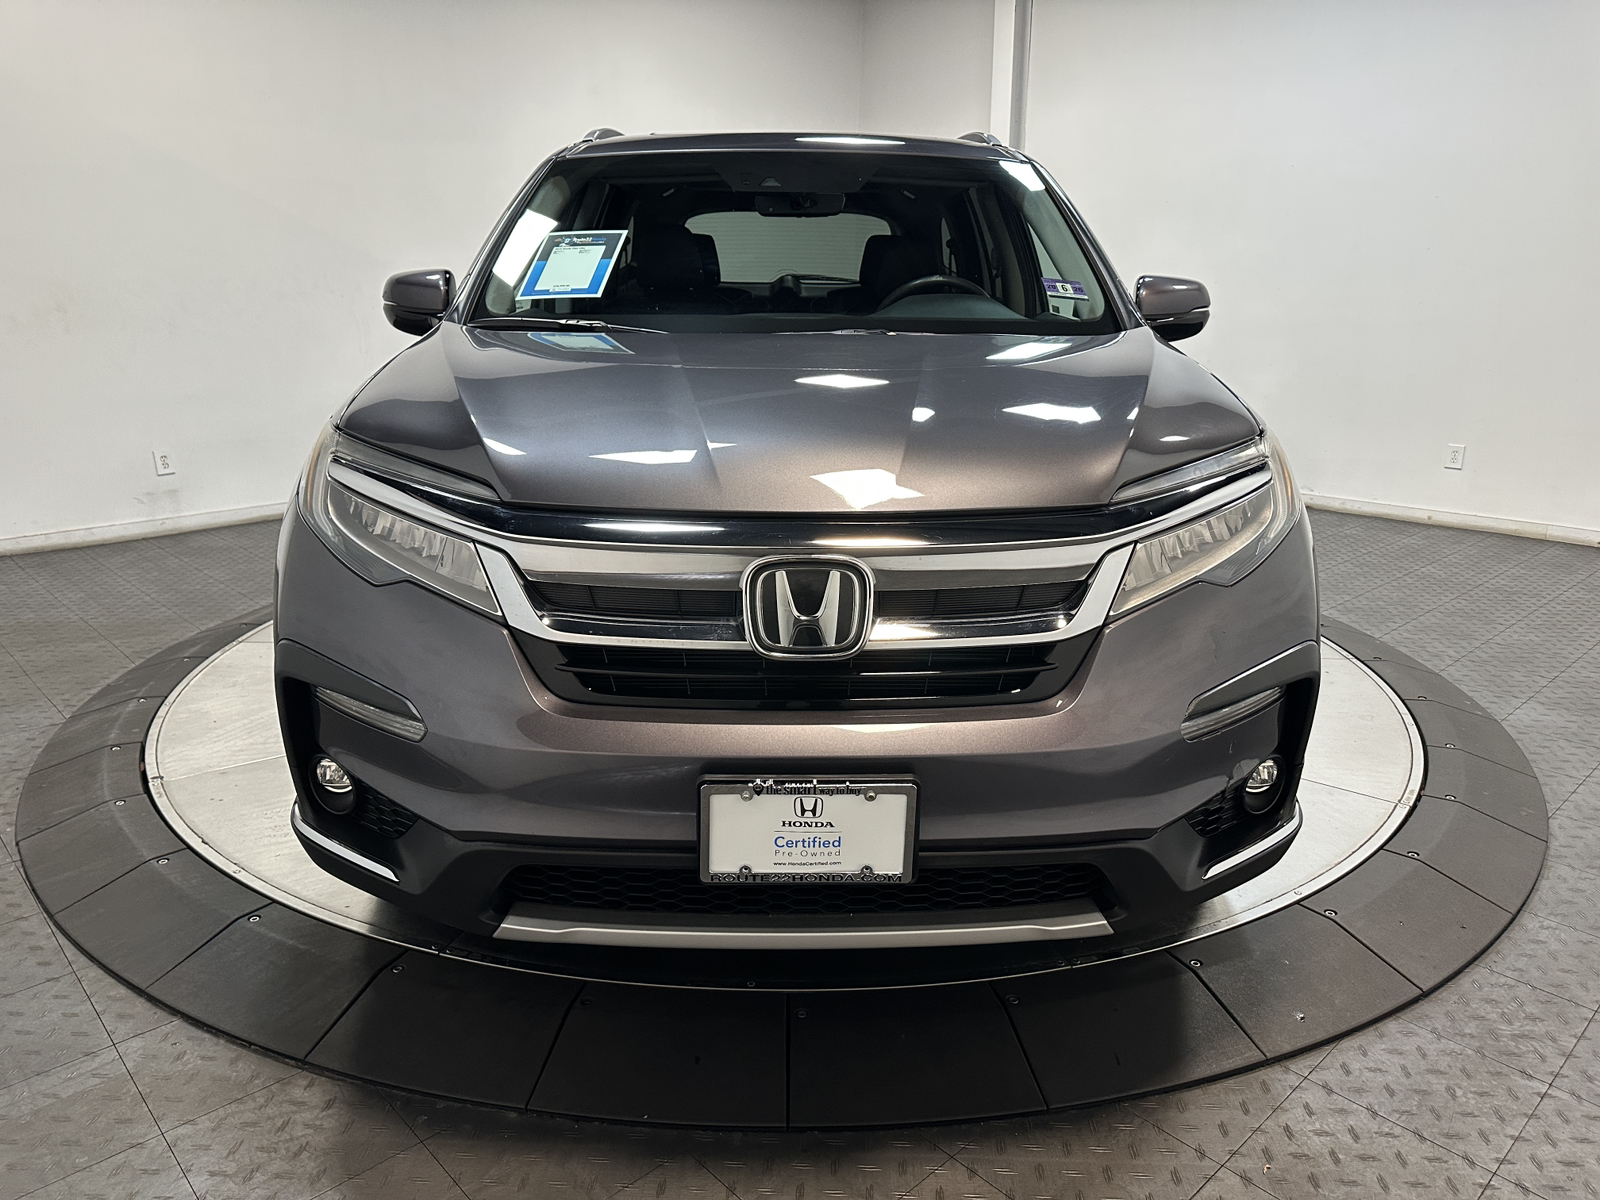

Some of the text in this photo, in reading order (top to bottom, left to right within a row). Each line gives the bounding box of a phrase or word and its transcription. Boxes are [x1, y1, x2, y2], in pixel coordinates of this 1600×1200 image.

[1061, 284, 1069, 292] 6
[766, 782, 862, 797] the smart way to buy
[780, 820, 835, 828] HONDA
[773, 835, 842, 848] Certified
[774, 849, 841, 857] Pre-Owned
